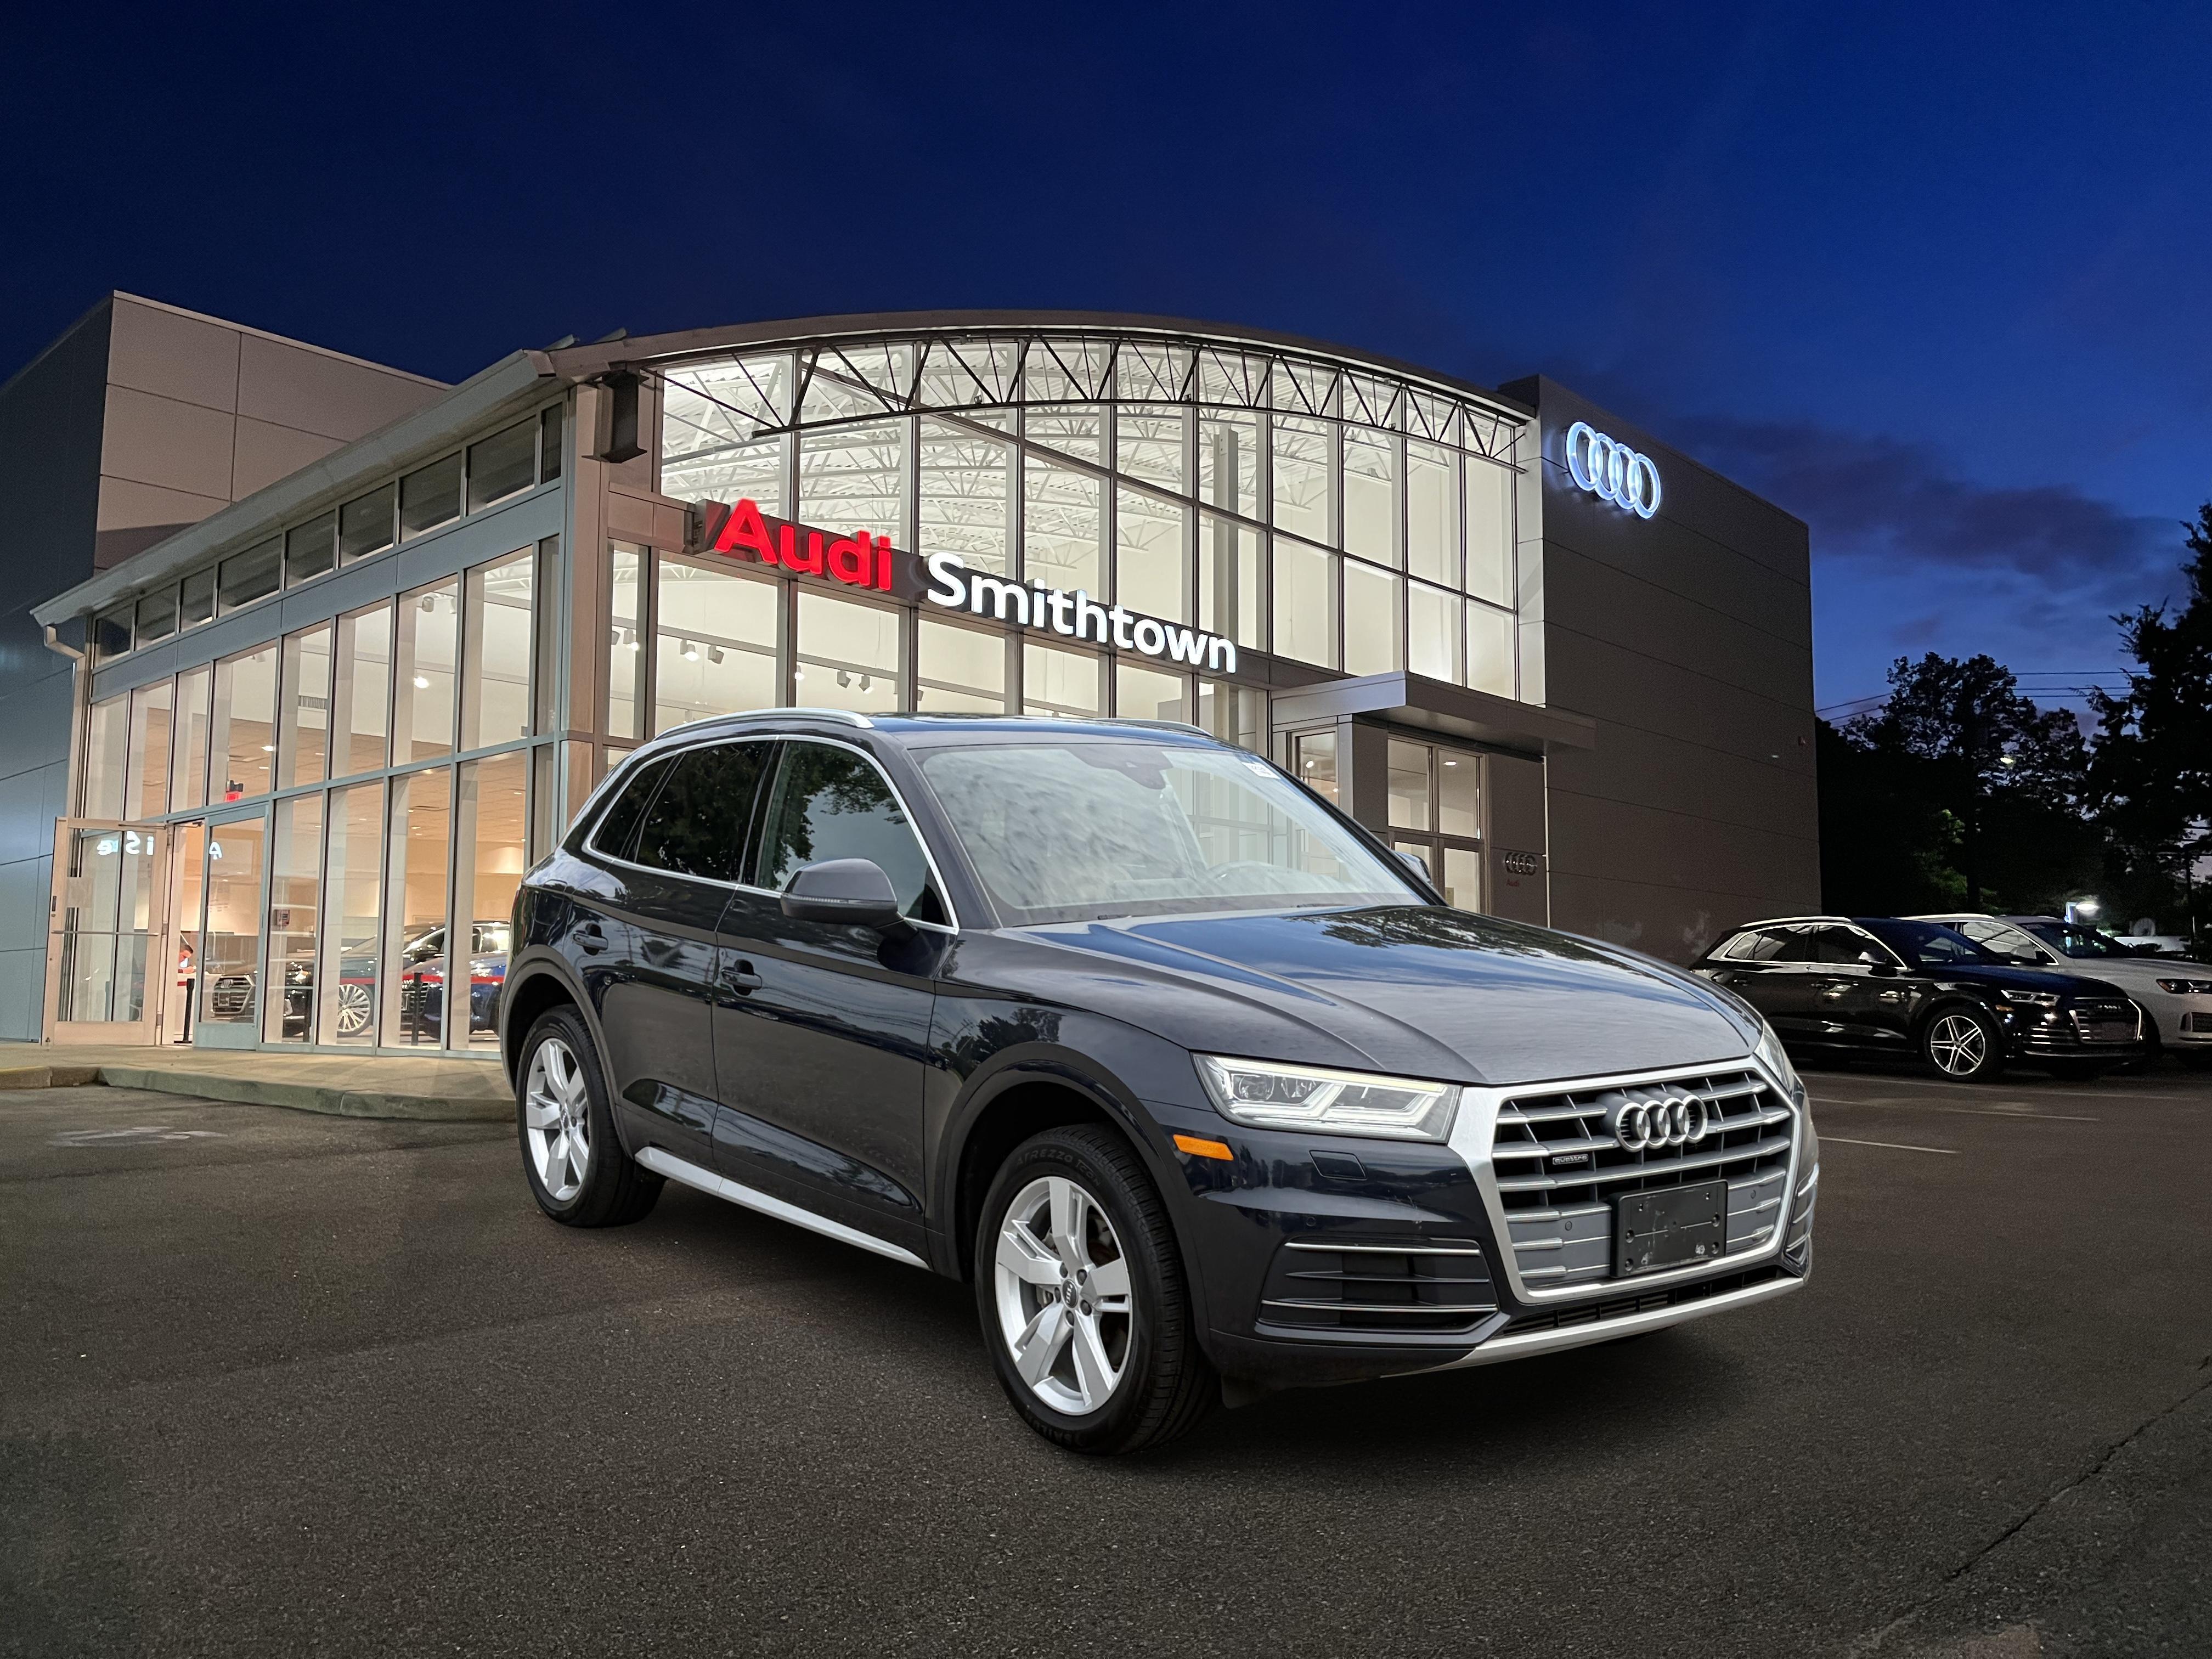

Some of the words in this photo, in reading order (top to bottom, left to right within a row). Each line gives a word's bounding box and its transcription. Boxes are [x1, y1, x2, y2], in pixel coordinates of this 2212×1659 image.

[714, 498, 891, 591] Audi
[927, 551, 1236, 673] Smithtown
[1554, 1155, 1588, 1164] quattro
